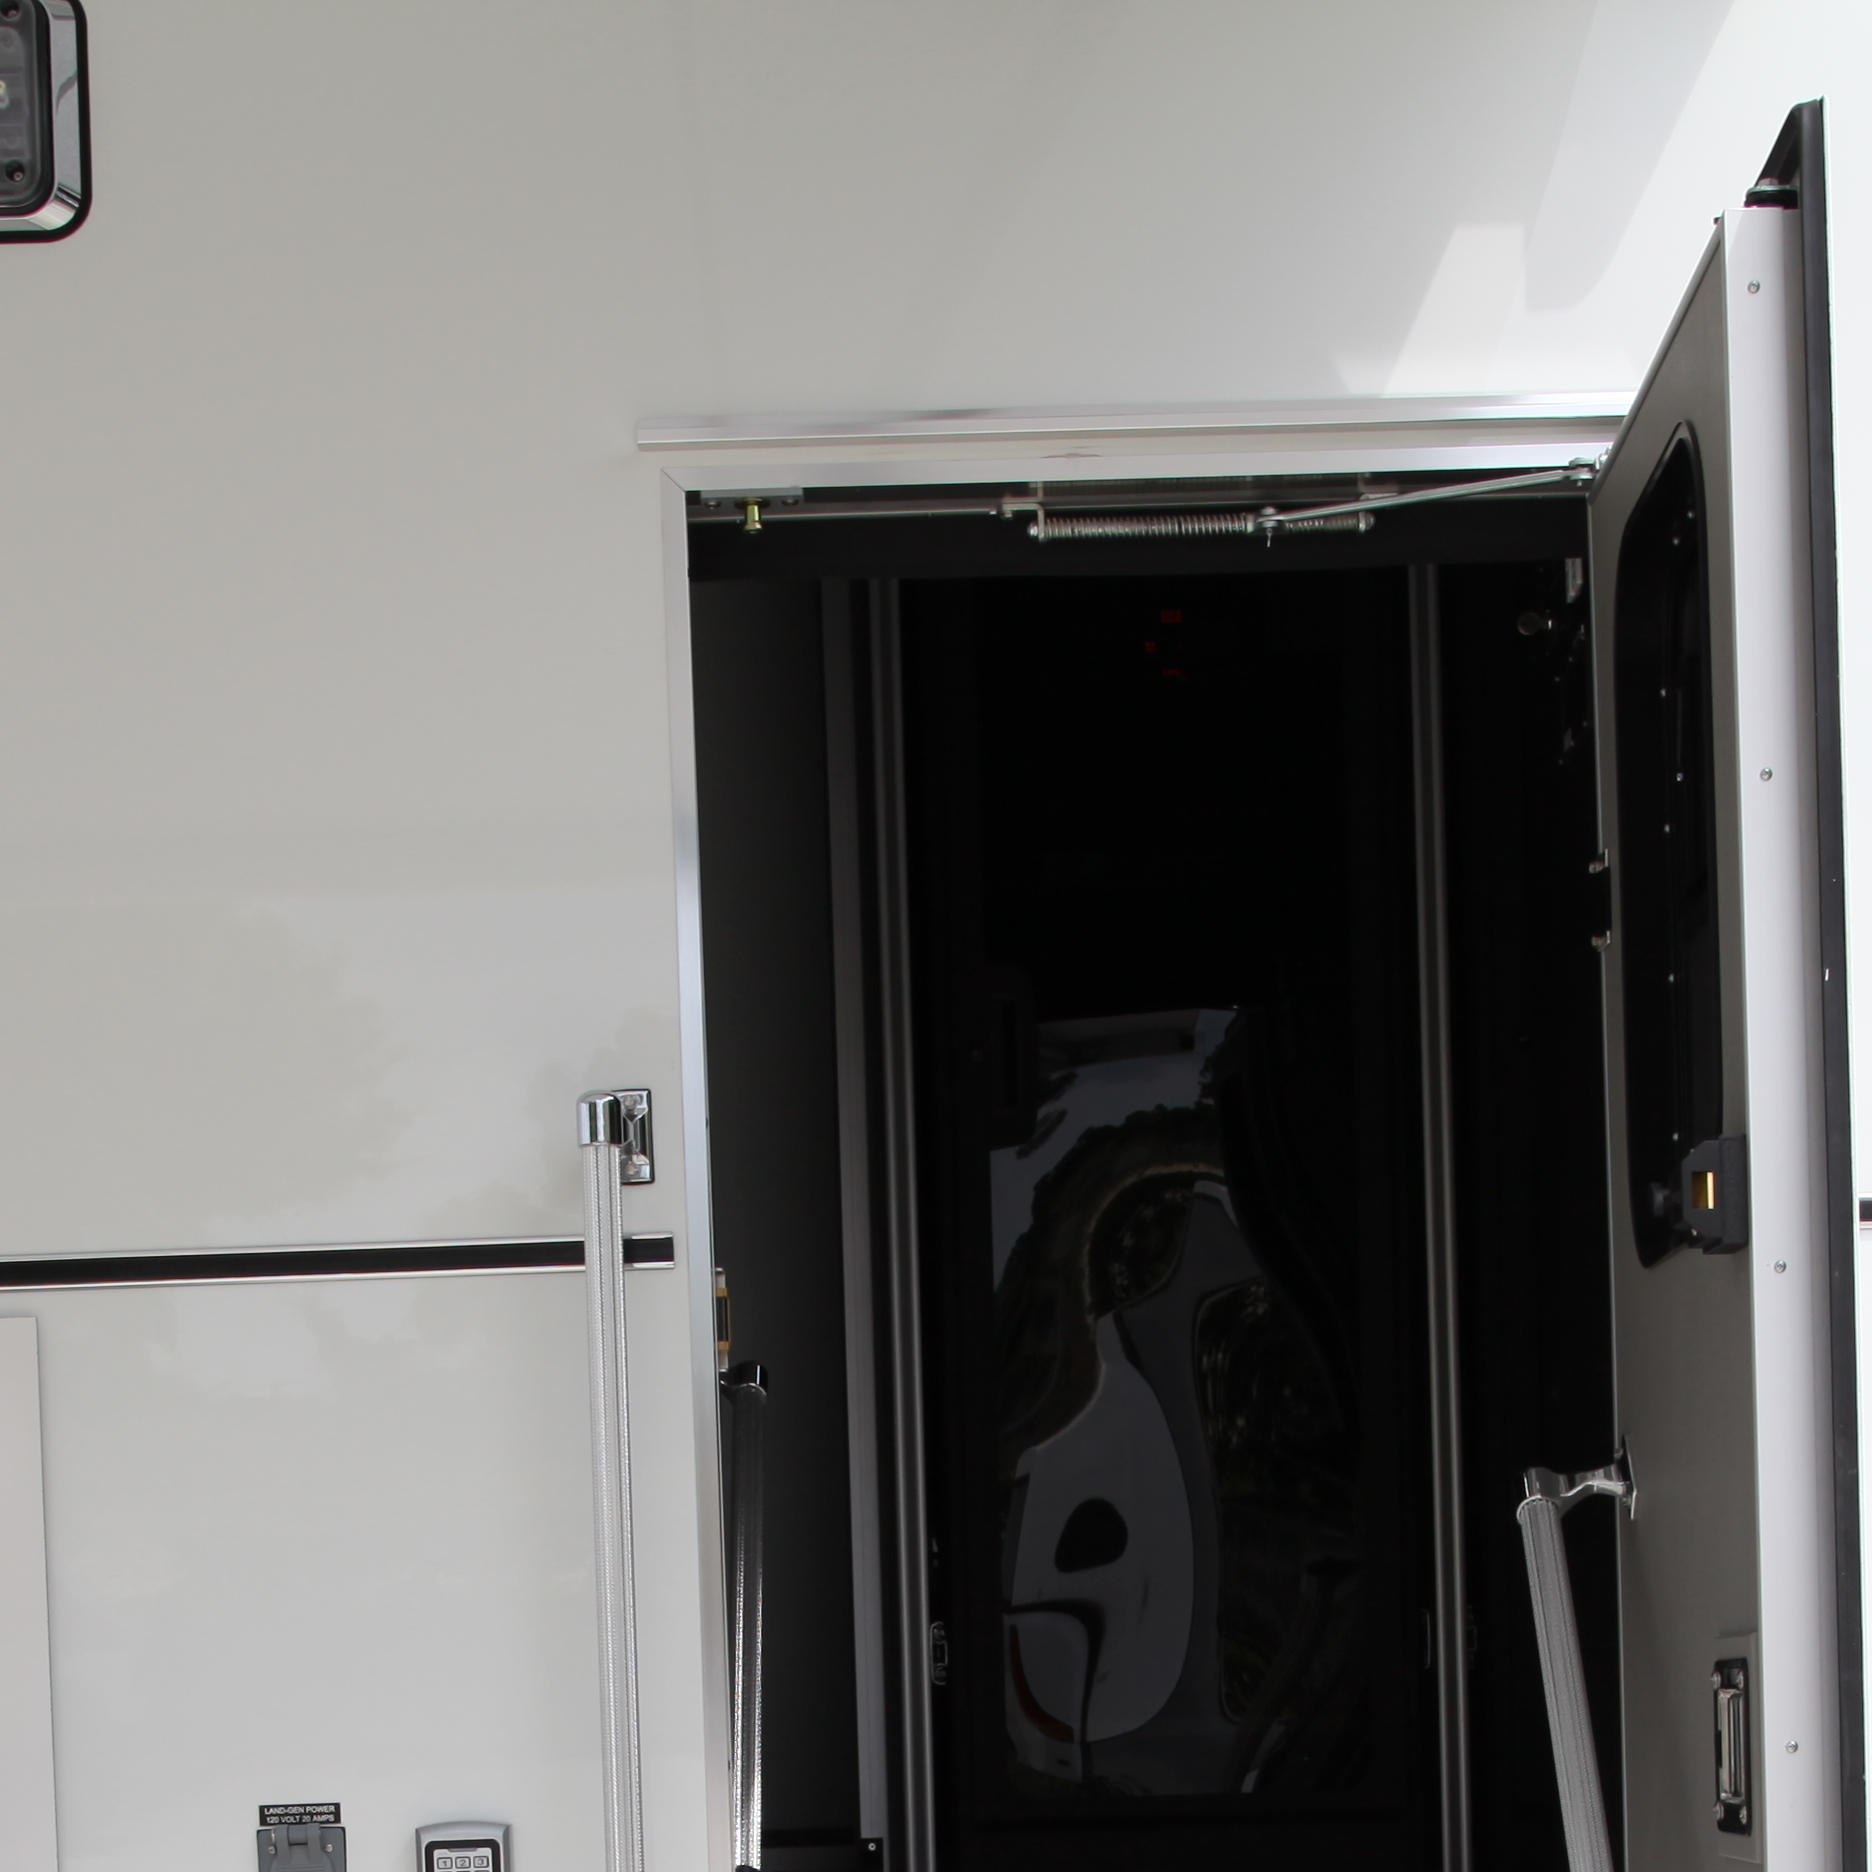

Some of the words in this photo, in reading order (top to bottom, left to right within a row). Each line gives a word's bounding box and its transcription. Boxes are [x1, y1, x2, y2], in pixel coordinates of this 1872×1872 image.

[264, 1806, 305, 1815] LAND-GEN
[306, 1805, 336, 1813] POWER
[266, 1816, 280, 1824] 120
[280, 1815, 301, 1823] VOLT
[312, 1814, 335, 1822] AMPS
